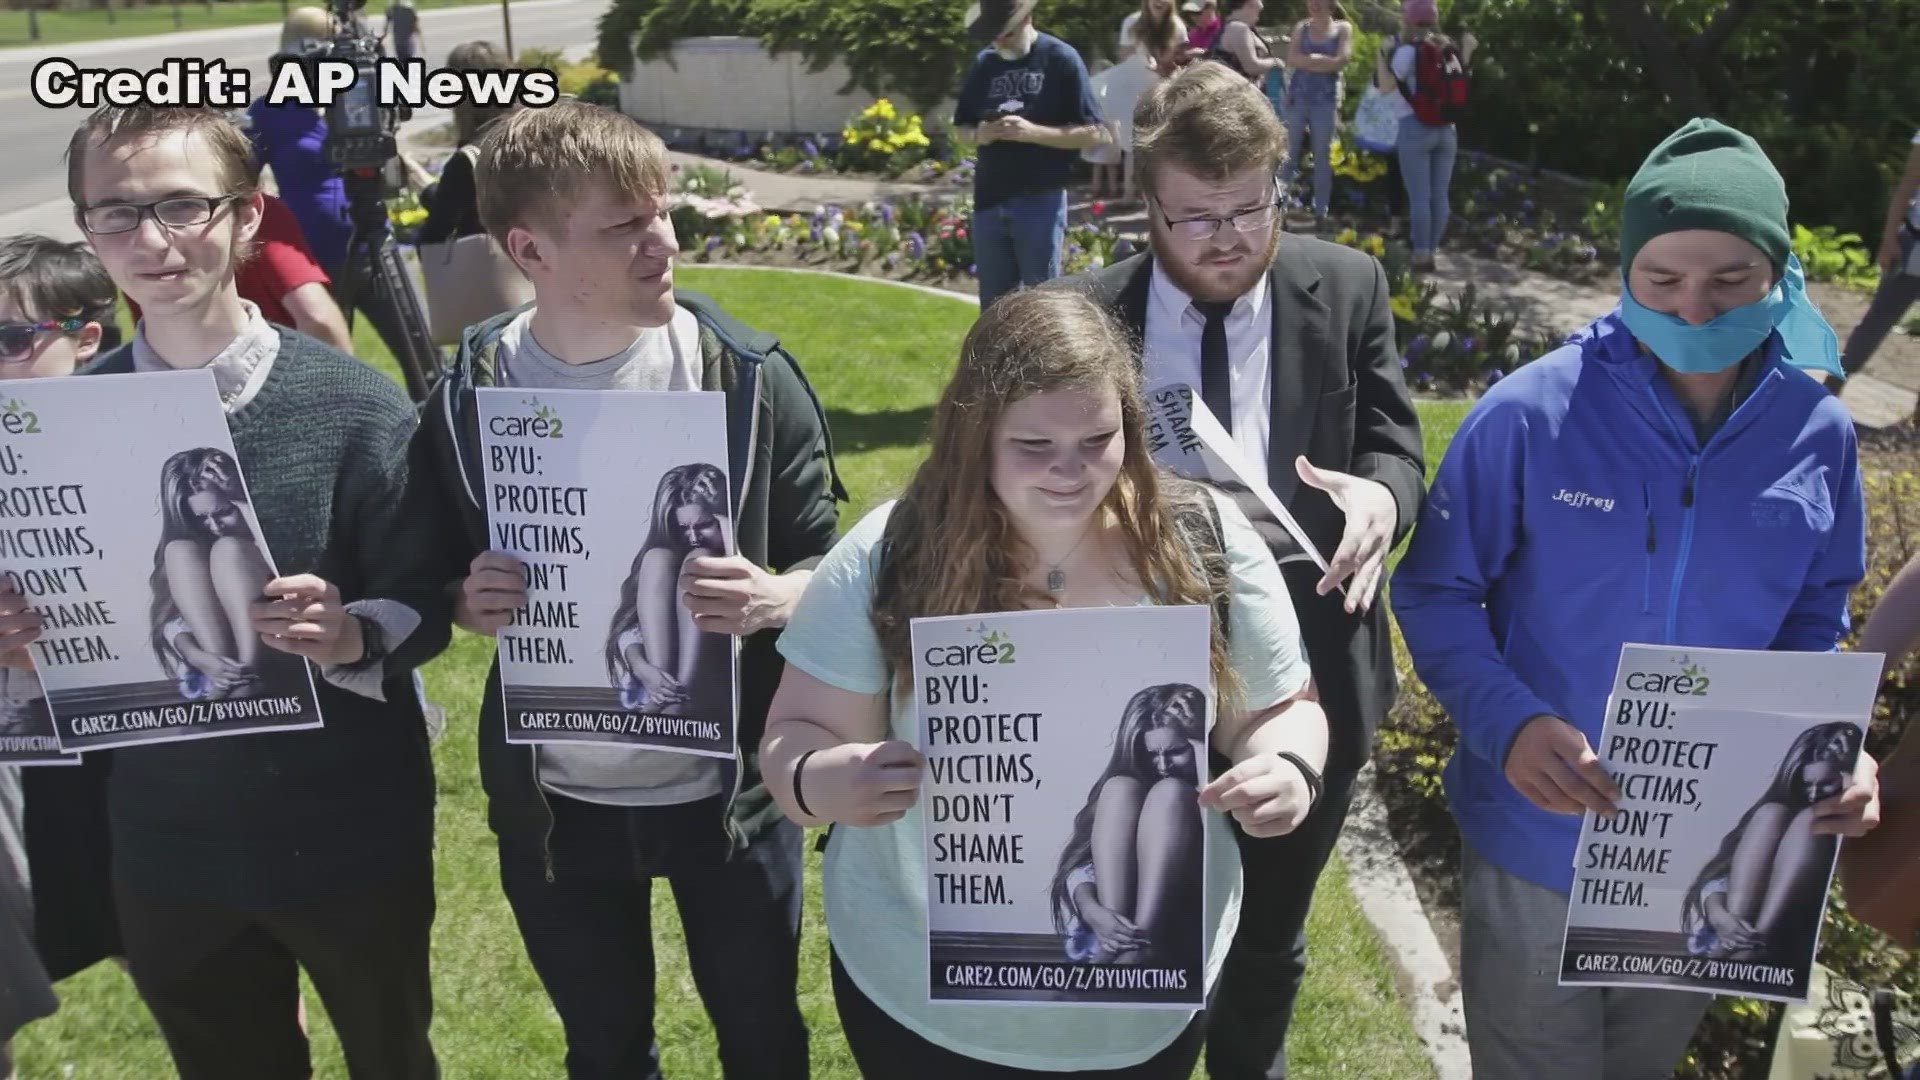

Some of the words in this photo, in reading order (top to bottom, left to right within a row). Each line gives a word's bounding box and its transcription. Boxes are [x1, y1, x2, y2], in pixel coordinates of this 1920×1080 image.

[989, 70, 1045, 98] BYU
[489, 415, 564, 438] care2
[1156, 391, 1204, 455] SHAME
[491, 445, 544, 476] BYU:
[0, 484, 87, 518] ROTECT
[494, 484, 588, 517] PROTECT
[1552, 488, 1615, 513] Jeffrey
[496, 523, 590, 561] VICTIMS,
[521, 561, 569, 592] ON'T
[34, 600, 117, 631] HAME
[34, 635, 120, 667] THEM.
[504, 635, 574, 665] THEM.
[925, 642, 1016, 667] care2
[925, 674, 989, 706] BYU:
[1626, 671, 1710, 696] care2
[71, 697, 301, 736] CARE2.COM/GO/Z/BYUVICTIMS
[520, 711, 721, 741] CARE2.COM/GO/Z/BYUVICTIMS
[928, 713, 1042, 746] PROTECT
[1616, 699, 1676, 730] BYU:
[1608, 735, 1718, 770] PROTECT
[928, 753, 1042, 790] VICTIMS,
[1612, 772, 1702, 812] ICTIMS,
[933, 794, 1014, 823] DON'T
[934, 833, 1024, 864] SHAME
[1586, 843, 1672, 874] SHAME
[934, 873, 1014, 905] THEM.
[1580, 878, 1649, 908] THEM.
[946, 965, 1187, 991] CARE2.COM/GO/Z/BYUVICTIMS
[1576, 953, 1794, 985] CARE2.COM/GO/Z/BYUVICTIMS
